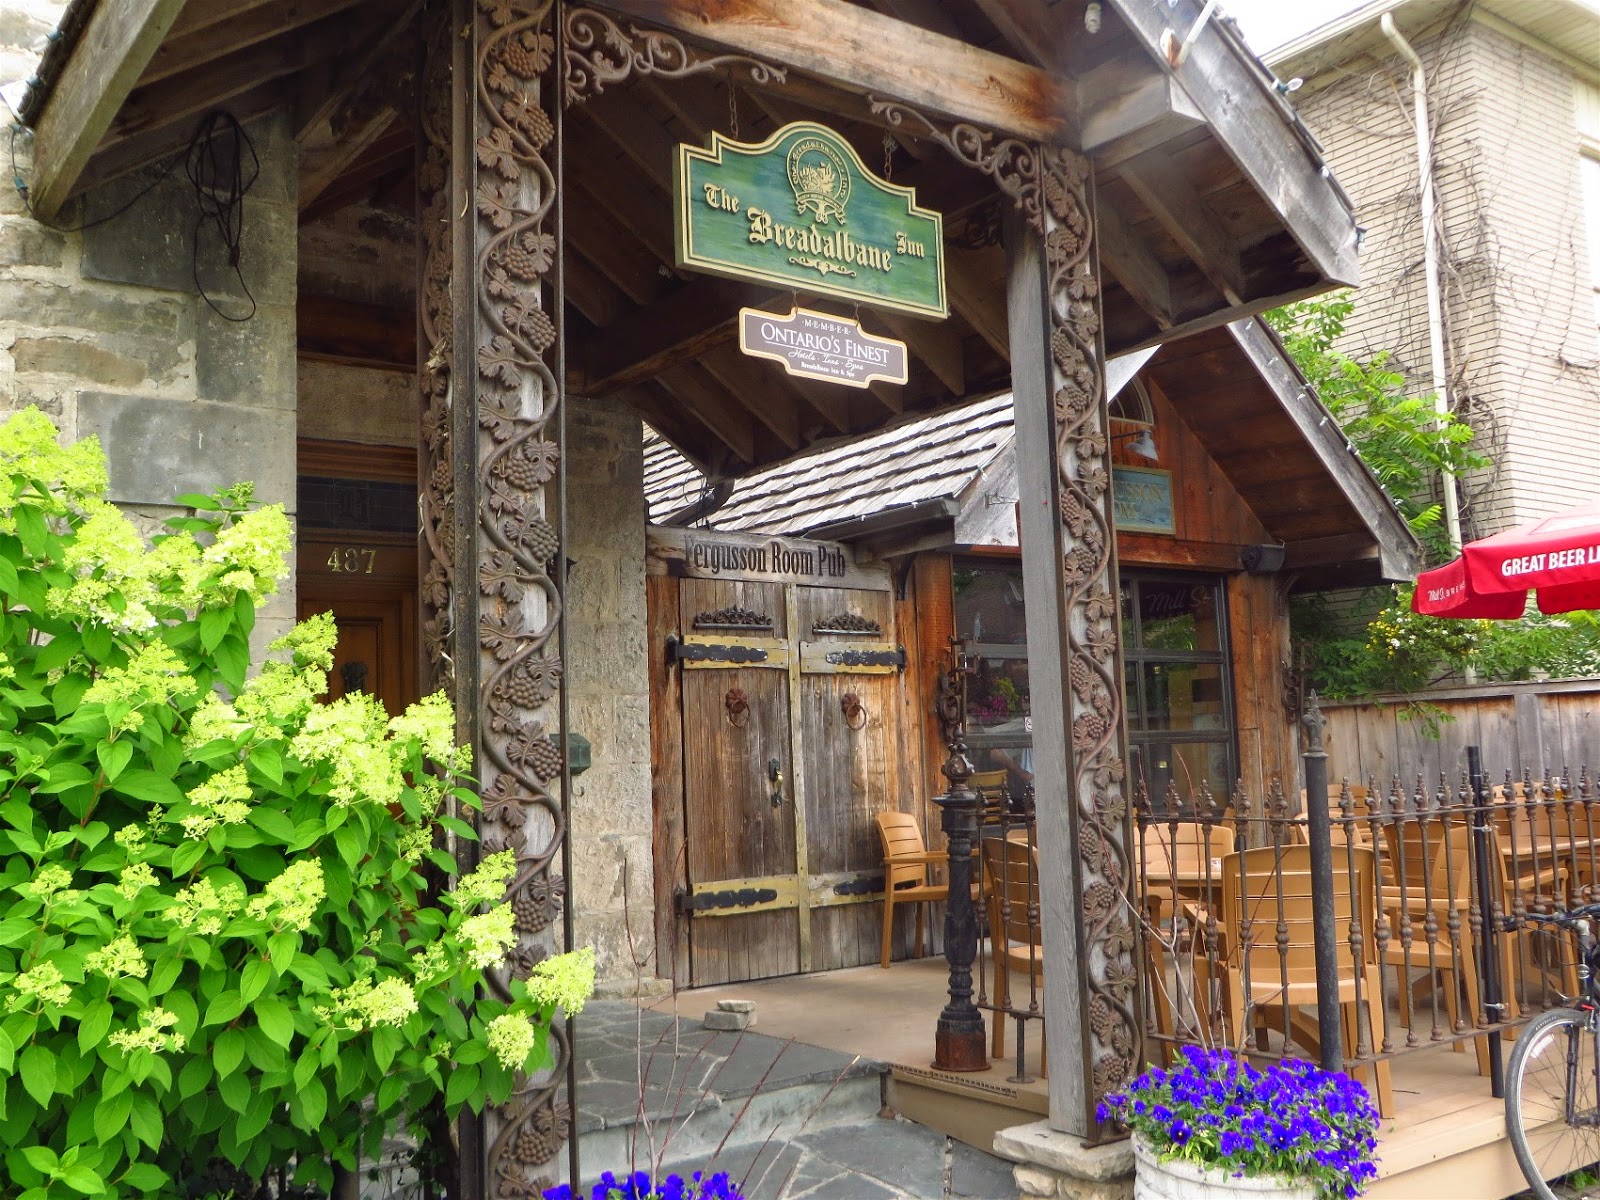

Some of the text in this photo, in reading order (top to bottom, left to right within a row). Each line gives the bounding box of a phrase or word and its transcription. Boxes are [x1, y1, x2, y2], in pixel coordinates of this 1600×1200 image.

[704, 183, 925, 272] The Breadalbane Inn
[760, 322, 890, 365] ONTARIO'S FINEST
[327, 547, 377, 574] 487
[771, 541, 814, 576] Room
[817, 545, 846, 578] Pub
[1501, 554, 1546, 577] GREAT
[1547, 547, 1586, 570] BEER
